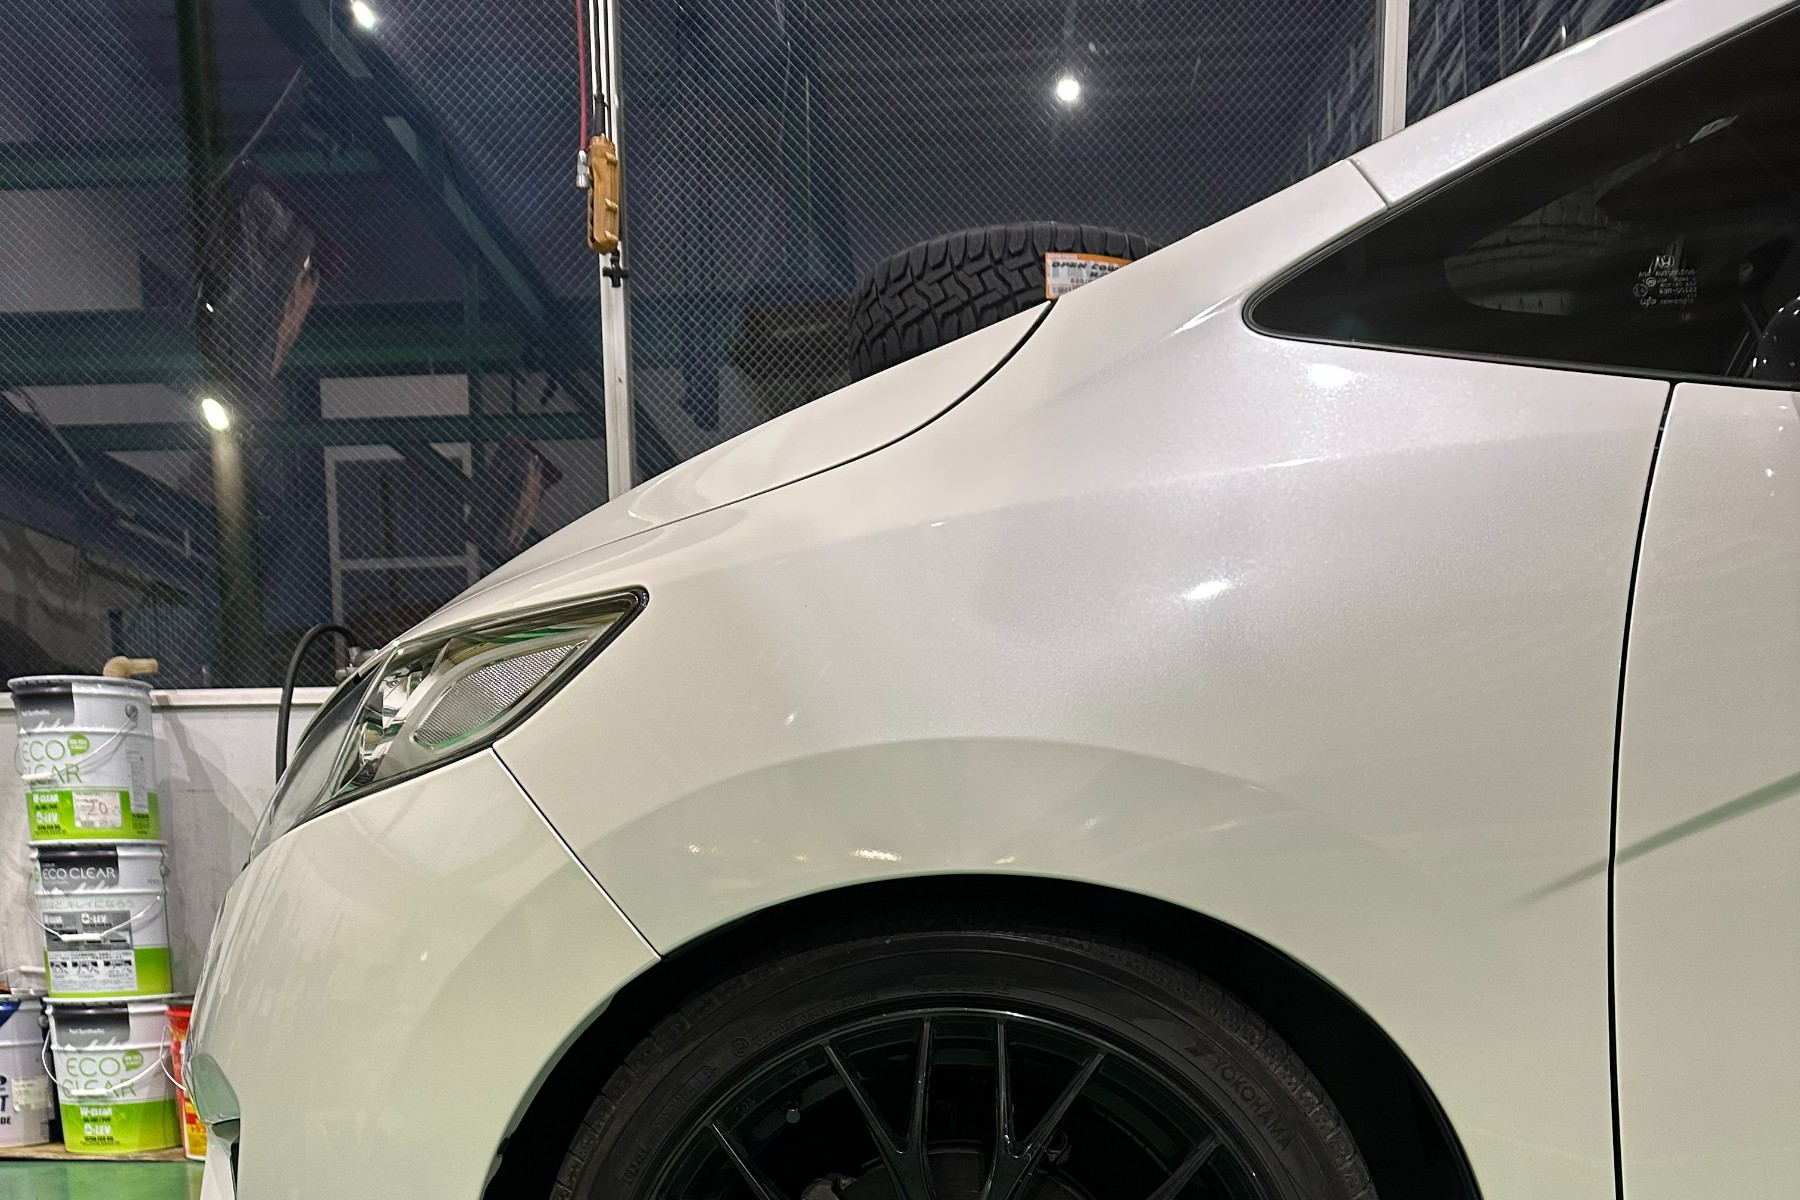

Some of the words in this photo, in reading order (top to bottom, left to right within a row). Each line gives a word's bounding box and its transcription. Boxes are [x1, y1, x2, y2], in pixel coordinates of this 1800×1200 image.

[22, 739, 66, 762] ECO
[43, 867, 67, 880] ECO
[69, 866, 116, 880] CLEAR
[66, 1056, 121, 1077] ECO
[1211, 1056, 1297, 1151] YOKOHAMA
